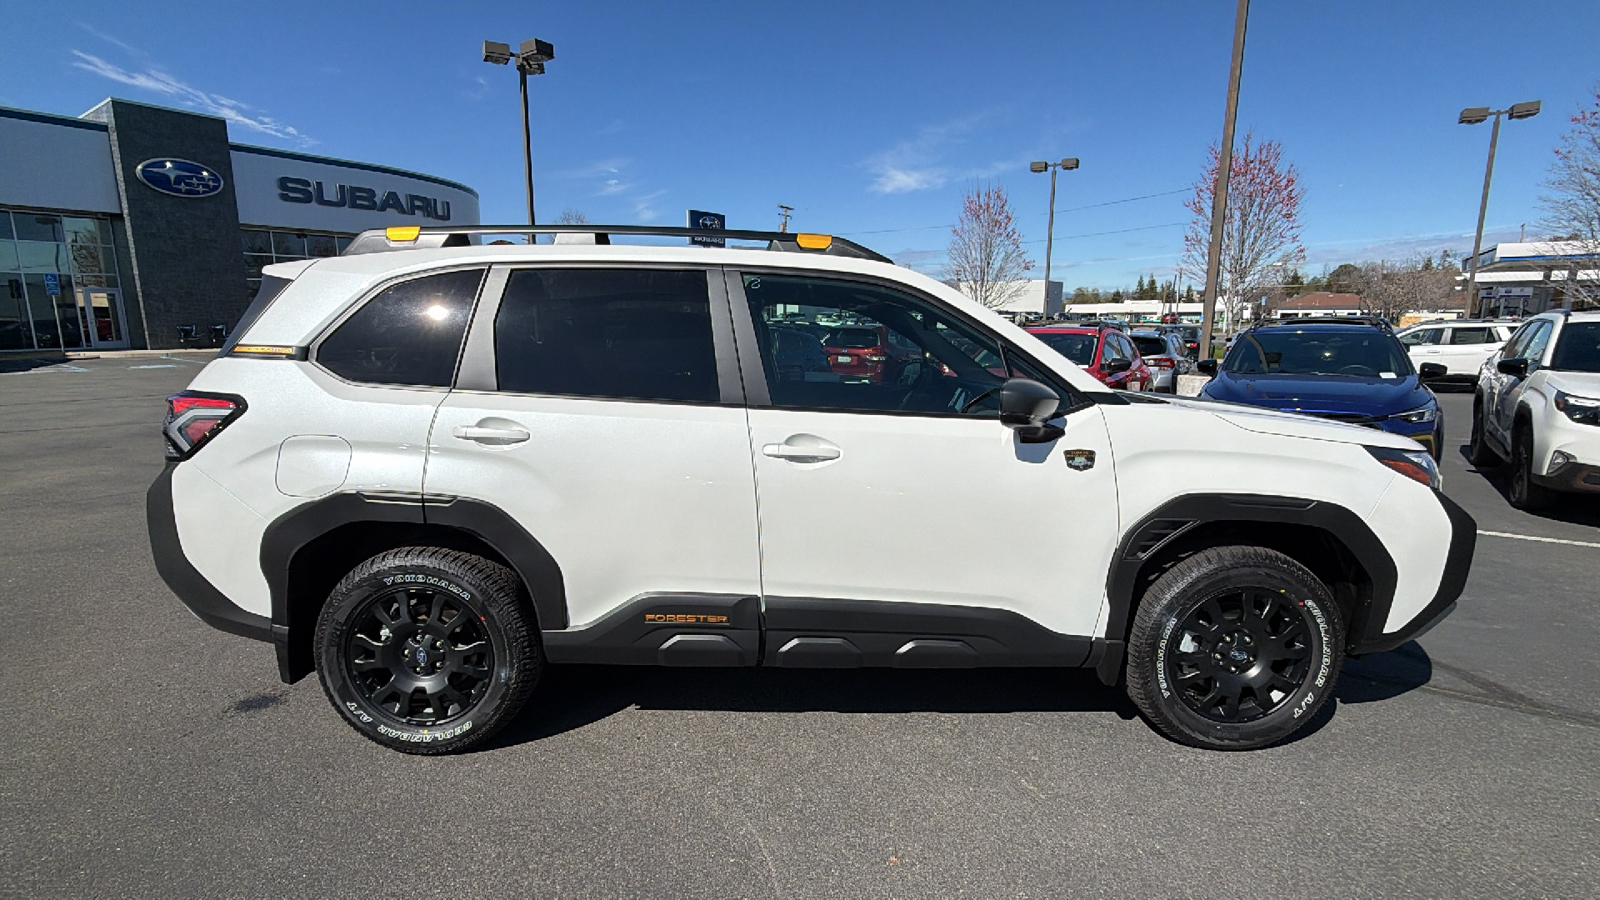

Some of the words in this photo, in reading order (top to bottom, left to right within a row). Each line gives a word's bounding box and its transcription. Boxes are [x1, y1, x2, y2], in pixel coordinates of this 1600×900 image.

[278, 176, 451, 221] SUBARU
[383, 575, 471, 600] YOKOHAMA
[645, 614, 728, 623] FORESTER
[1304, 599, 1331, 688] GEOLANDAR
[1156, 617, 1178, 699] YOKOHAMA
[346, 701, 373, 723] A/T
[1293, 691, 1315, 719] A/T
[377, 720, 473, 742] GEOLANDAR
